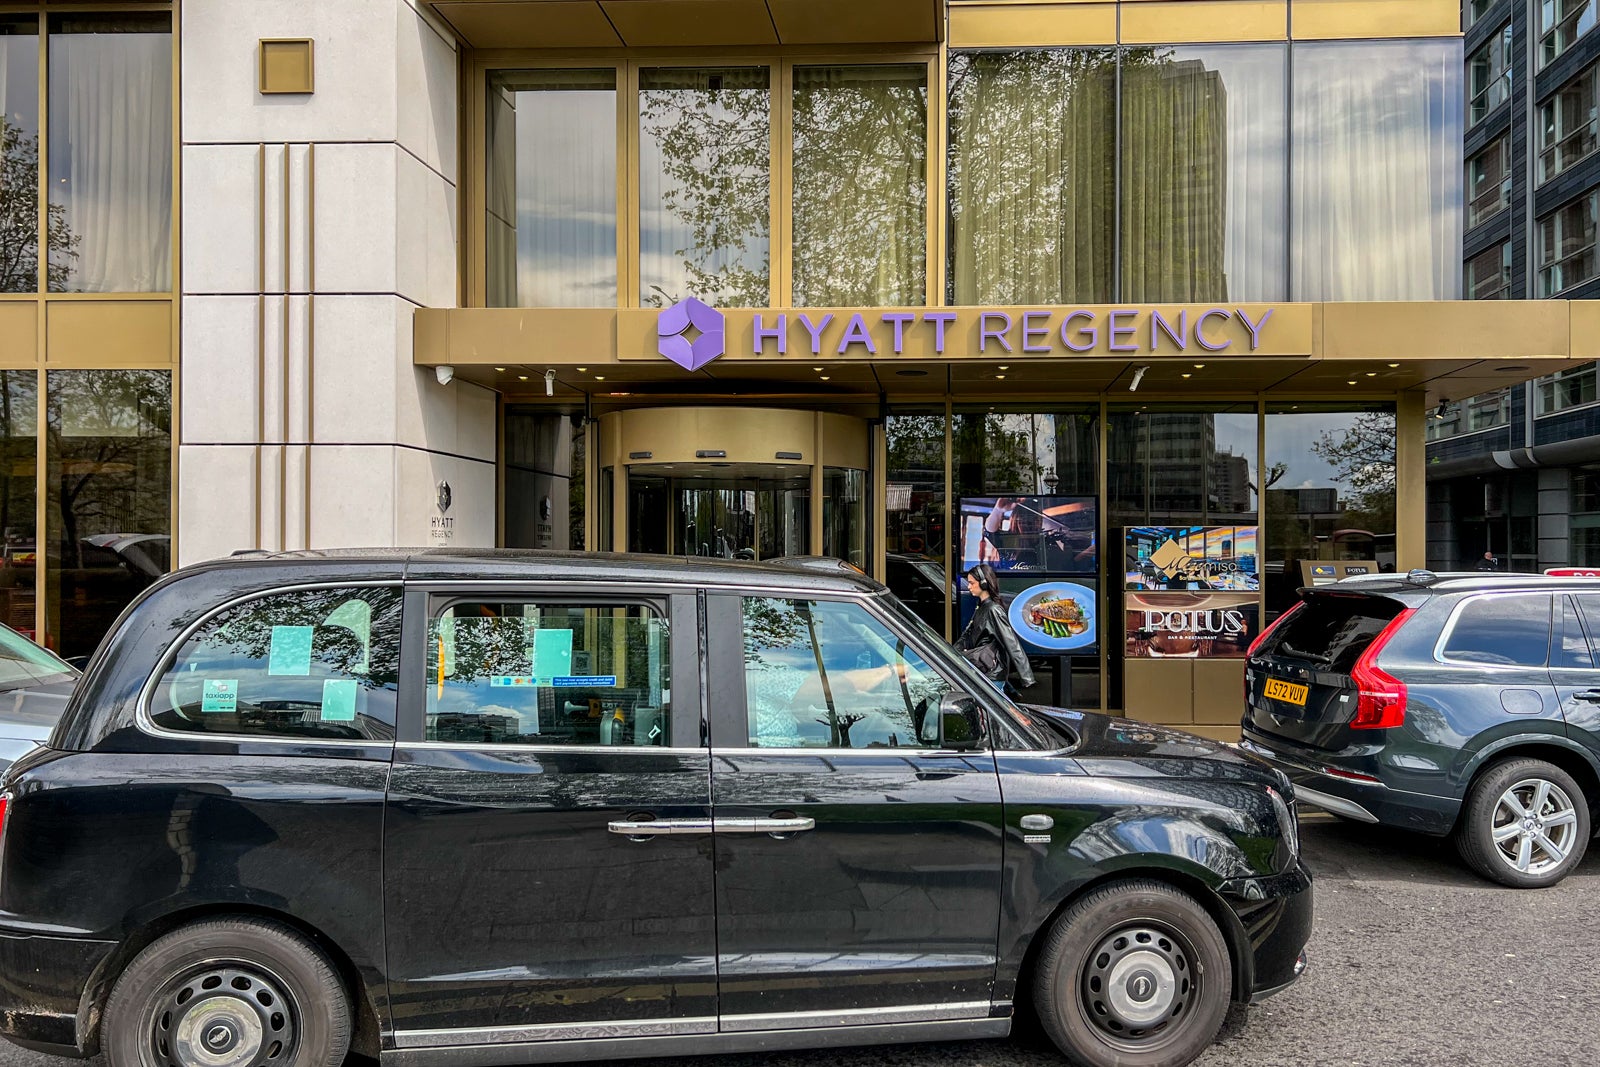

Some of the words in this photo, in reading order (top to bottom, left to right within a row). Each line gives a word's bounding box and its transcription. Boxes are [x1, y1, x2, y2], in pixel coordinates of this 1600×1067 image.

[753, 313, 957, 354] HYATT
[980, 308, 1274, 354] REGENCY
[431, 517, 454, 528] HYATT
[431, 529, 454, 538] REGENCY
[1144, 610, 1244, 633] POTUS
[1268, 681, 1288, 698] LS72
